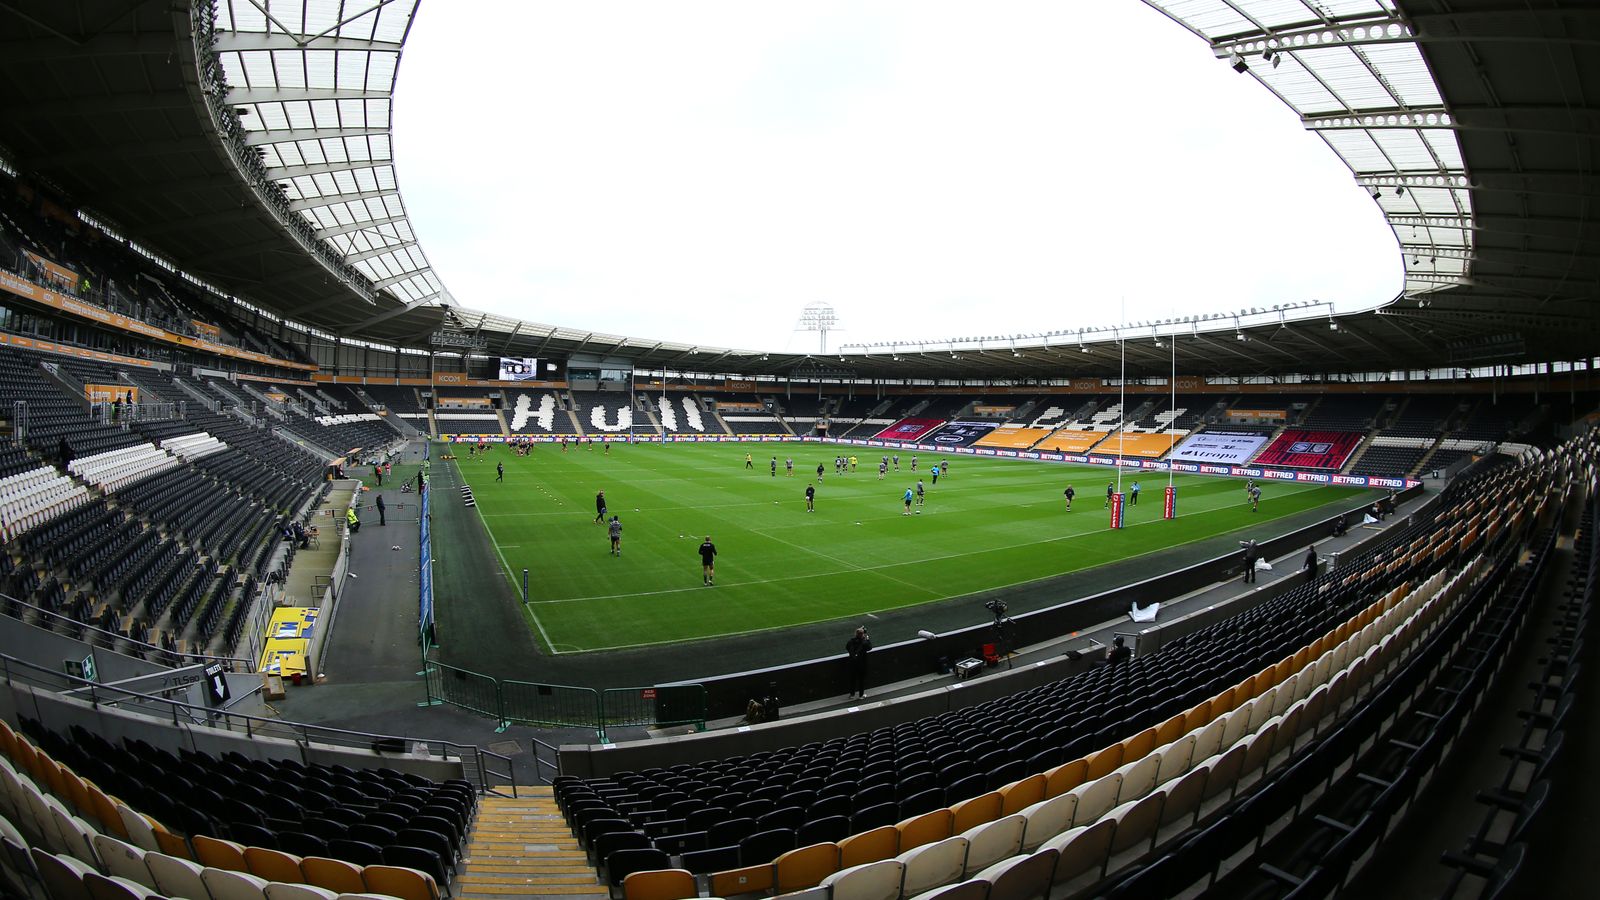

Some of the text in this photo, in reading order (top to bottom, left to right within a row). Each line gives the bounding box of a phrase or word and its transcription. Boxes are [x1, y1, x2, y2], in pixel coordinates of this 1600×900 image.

[731, 382, 752, 390] KCOM
[1074, 382, 1096, 390] KCOM
[1019, 451, 1039, 459] BETFRED
[1041, 453, 1062, 461] BETFRED
[1089, 457, 1112, 465] BETFRED
[1142, 460, 1168, 469] BETFRED
[1171, 462, 1198, 471] BETFRED
[1200, 465, 1228, 474] BETFRED
[1231, 468, 1260, 477] BETFRED
[1264, 470, 1293, 479] BETFRED
[1297, 474, 1328, 482] BETFRED
[1332, 475, 1365, 485] BETFRED
[1369, 478, 1402, 487] BETFRED
[206, 663, 222, 676] TOILETS
